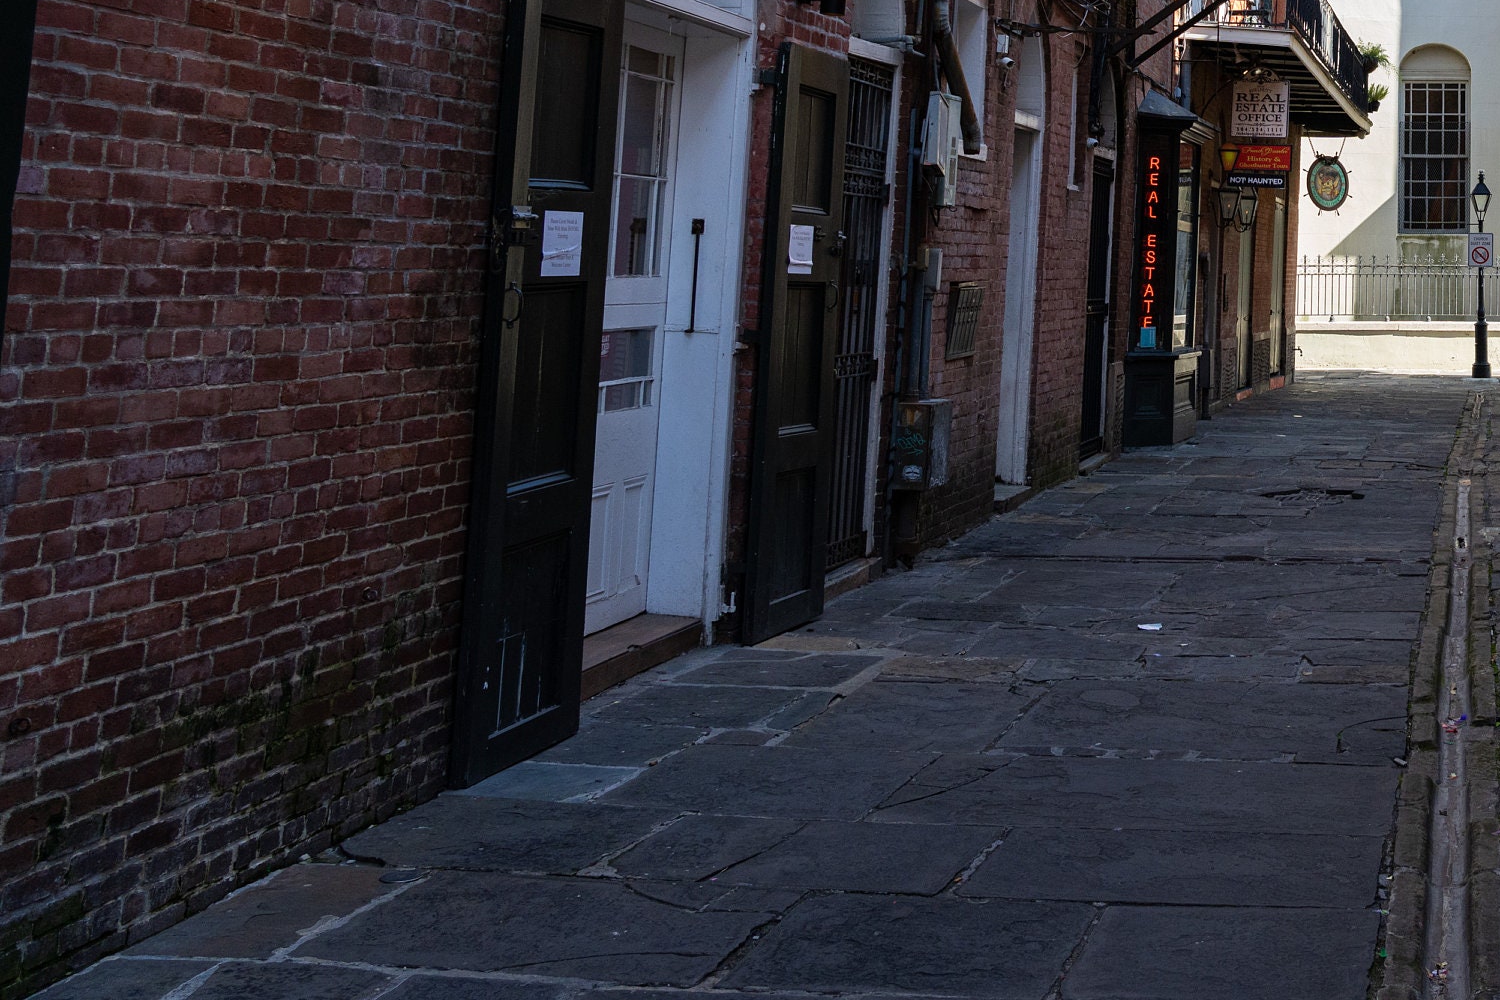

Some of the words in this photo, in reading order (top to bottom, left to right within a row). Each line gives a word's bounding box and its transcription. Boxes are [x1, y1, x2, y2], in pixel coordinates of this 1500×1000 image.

[1236, 93, 1286, 102] REAL
[1235, 103, 1286, 113] ESTATE
[1238, 113, 1282, 122] OFFICE
[1247, 177, 1283, 185] HAUNTED
[1147, 156, 1160, 219] REAL
[1143, 234, 1157, 329] ESTATE
